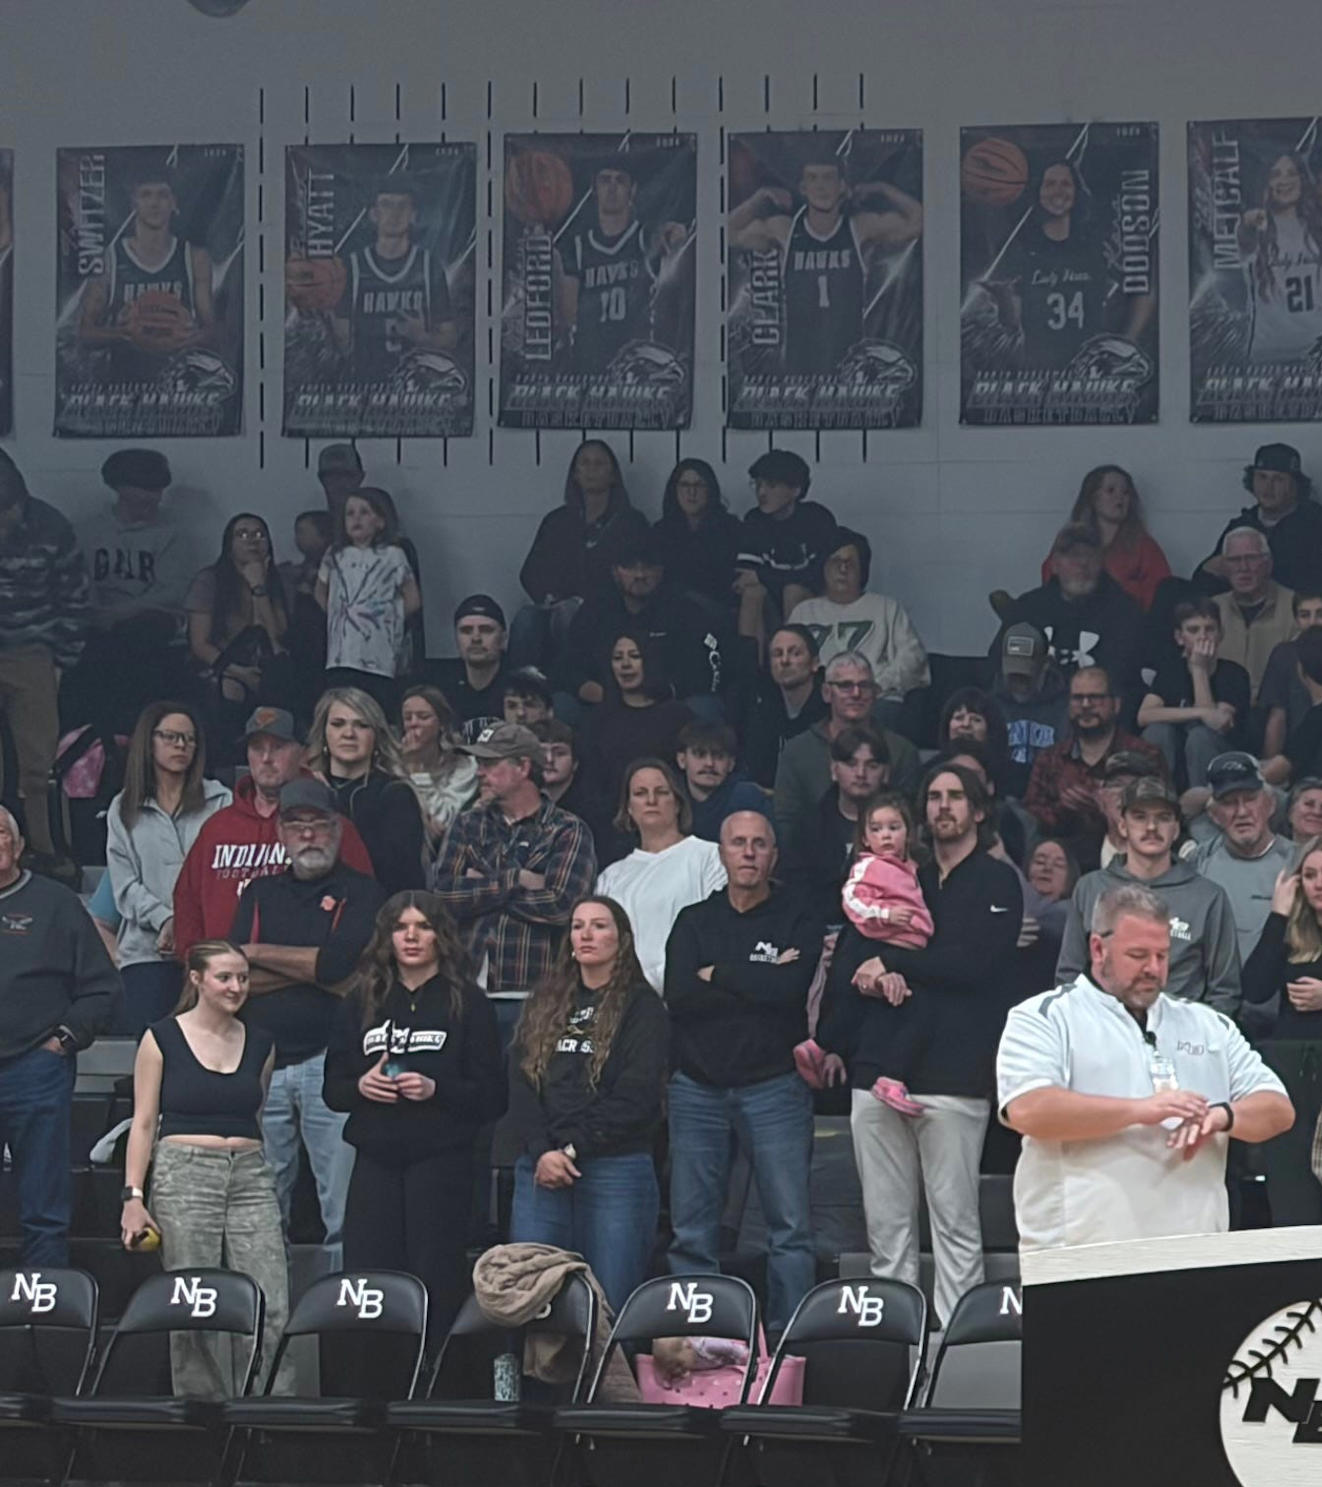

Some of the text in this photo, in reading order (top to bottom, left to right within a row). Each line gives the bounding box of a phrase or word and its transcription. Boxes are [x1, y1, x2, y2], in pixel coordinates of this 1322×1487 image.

[78, 154, 107, 278] SWITZER
[307, 167, 336, 259] HYATT
[1212, 128, 1241, 271] METCALF
[1121, 170, 1151, 295] DODSON
[525, 231, 553, 362] LEDFORD
[600, 285, 626, 323] 10
[752, 248, 780, 347] CLARK
[818, 275, 830, 308] 1
[1047, 291, 1085, 331] 34
[1285, 275, 1314, 313] 21
[212, 842, 293, 869] INDIAN
[11, 1273, 56, 1312] NB
[170, 1277, 218, 1318] NB
[337, 1279, 384, 1319] NB
[667, 1283, 713, 1323] NB
[837, 1286, 884, 1327] NB
